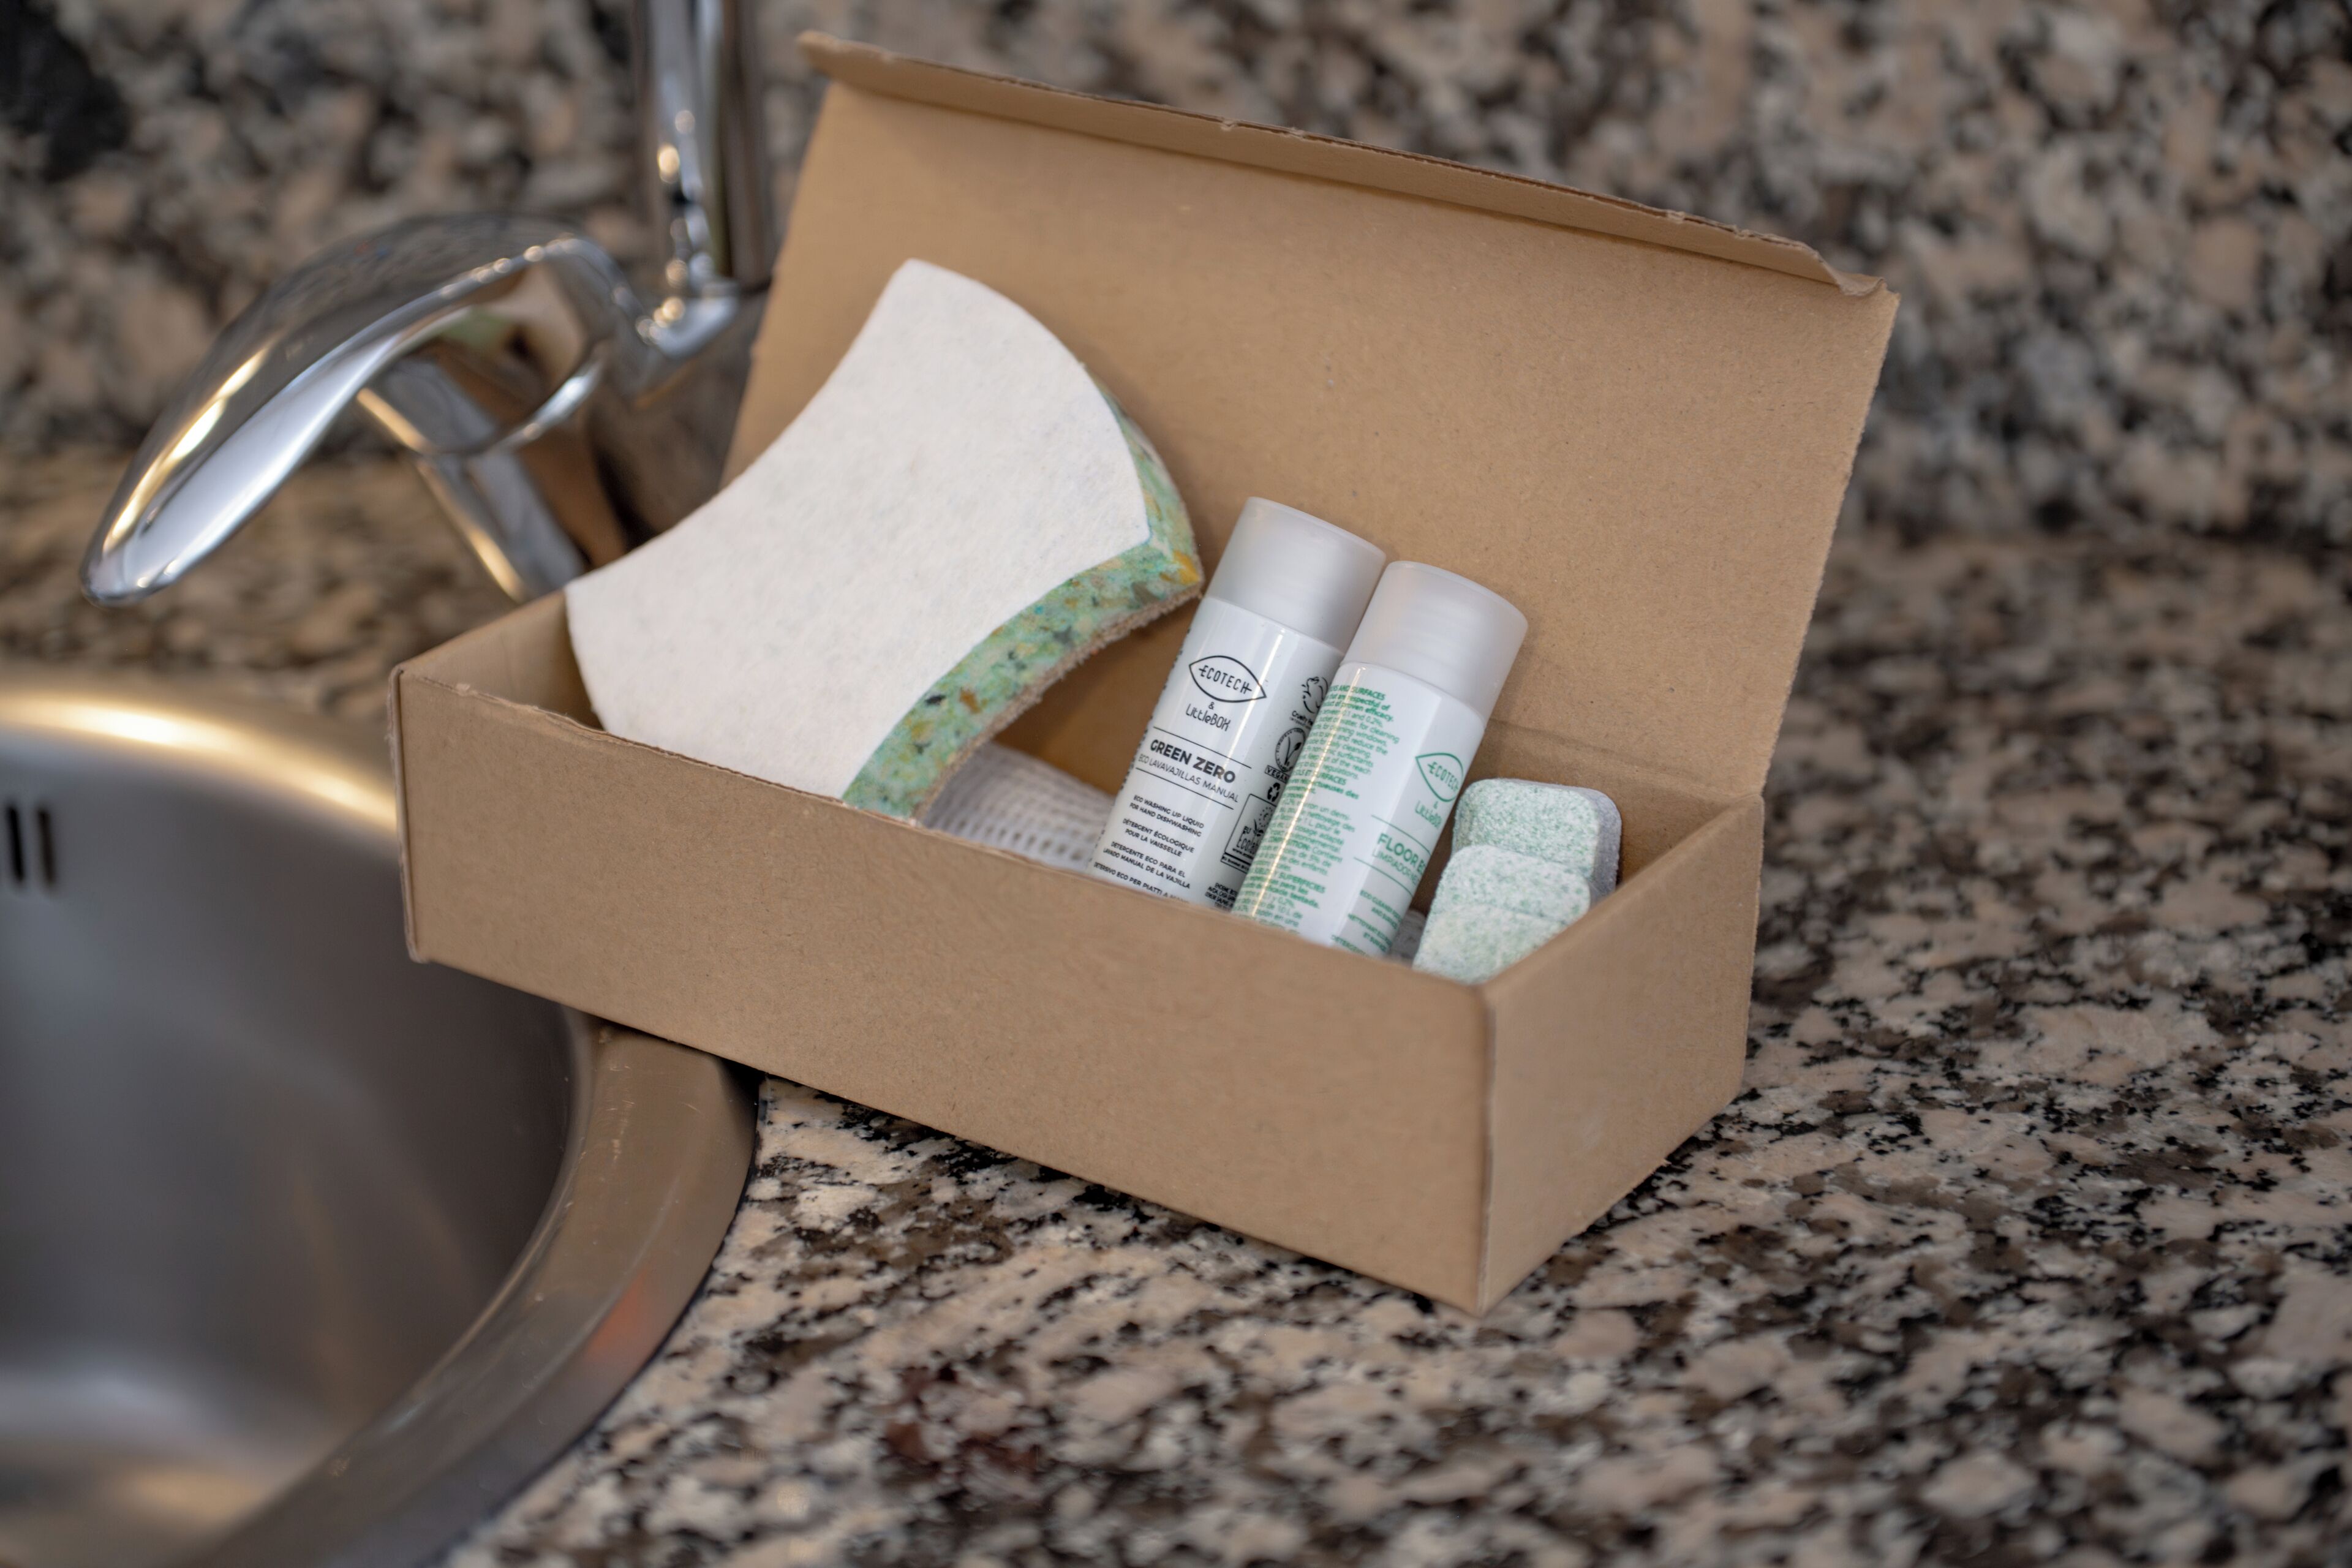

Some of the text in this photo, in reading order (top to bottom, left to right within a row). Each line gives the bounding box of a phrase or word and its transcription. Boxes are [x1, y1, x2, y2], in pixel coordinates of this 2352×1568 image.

[1199, 665, 1252, 694] ECOTECH
[1208, 701, 1215, 710] &
[1352, 712, 1365, 720] and
[1352, 738, 1374, 750] reduce
[1376, 745, 1389, 756] the
[1370, 727, 1400, 744] cleaning
[1150, 739, 1235, 783] GREEN ZERO
[1138, 754, 1238, 803] ECO LAVAVAJILLAS MANUAL
[1315, 772, 1346, 785] URFACES
[1139, 806, 1156, 817] HAND
[1156, 813, 1202, 837] DISHWASHING
[1144, 800, 1171, 815] WASHING
[1183, 815, 1204, 829] LIQUID
[1122, 818, 1195, 853] DÉTERGENT ÉCOLOGIQUE
[1125, 828, 1140, 839] POUR
[1150, 839, 1183, 857] VAISSELLE
[1377, 832, 1419, 867] FLOOR
[1110, 841, 1144, 859] DETERGENTE
[1145, 855, 1158, 865] ECO
[1159, 862, 1177, 873] PARA
[1121, 854, 1144, 869] MANUAL
[1155, 869, 1164, 878] LA
[1166, 874, 1191, 889] VAJILLA
[1117, 872, 1129, 881] ECO
[1129, 877, 1142, 886] PER
